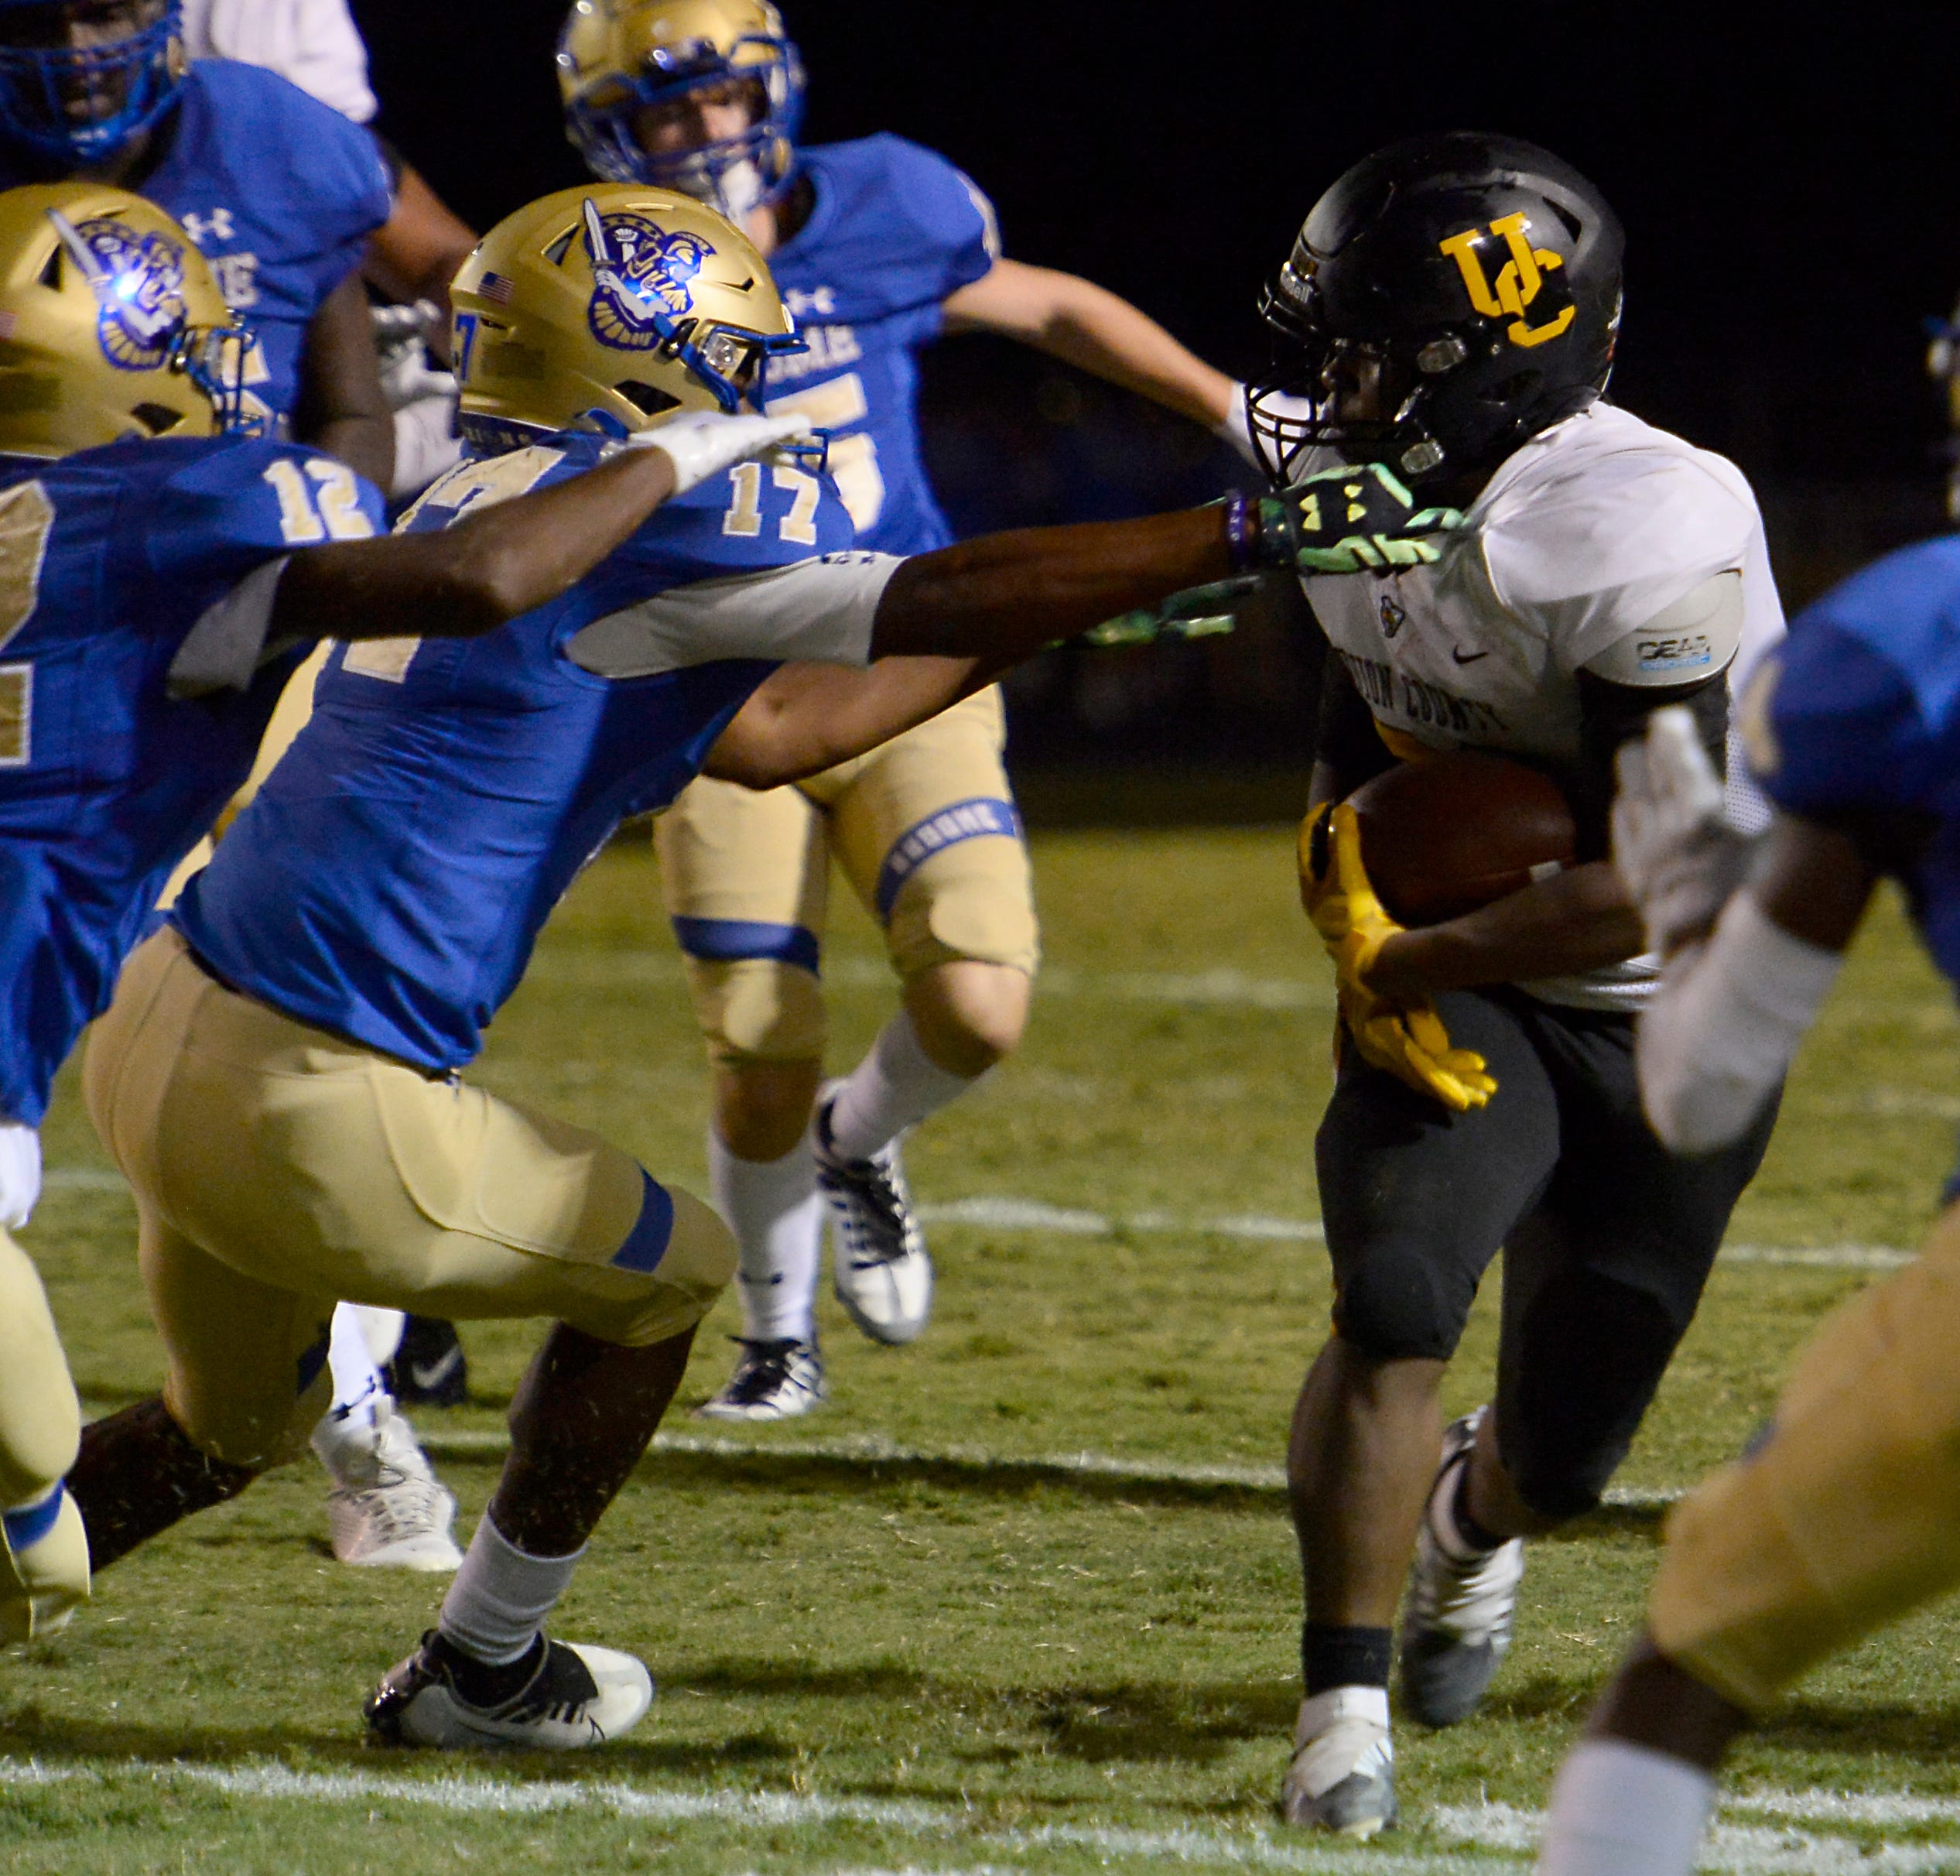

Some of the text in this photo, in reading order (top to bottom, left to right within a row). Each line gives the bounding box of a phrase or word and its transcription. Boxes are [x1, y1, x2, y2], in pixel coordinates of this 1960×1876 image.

[1439, 211, 1576, 348] UC
[262, 457, 377, 543] 12
[721, 460, 823, 546] 17
